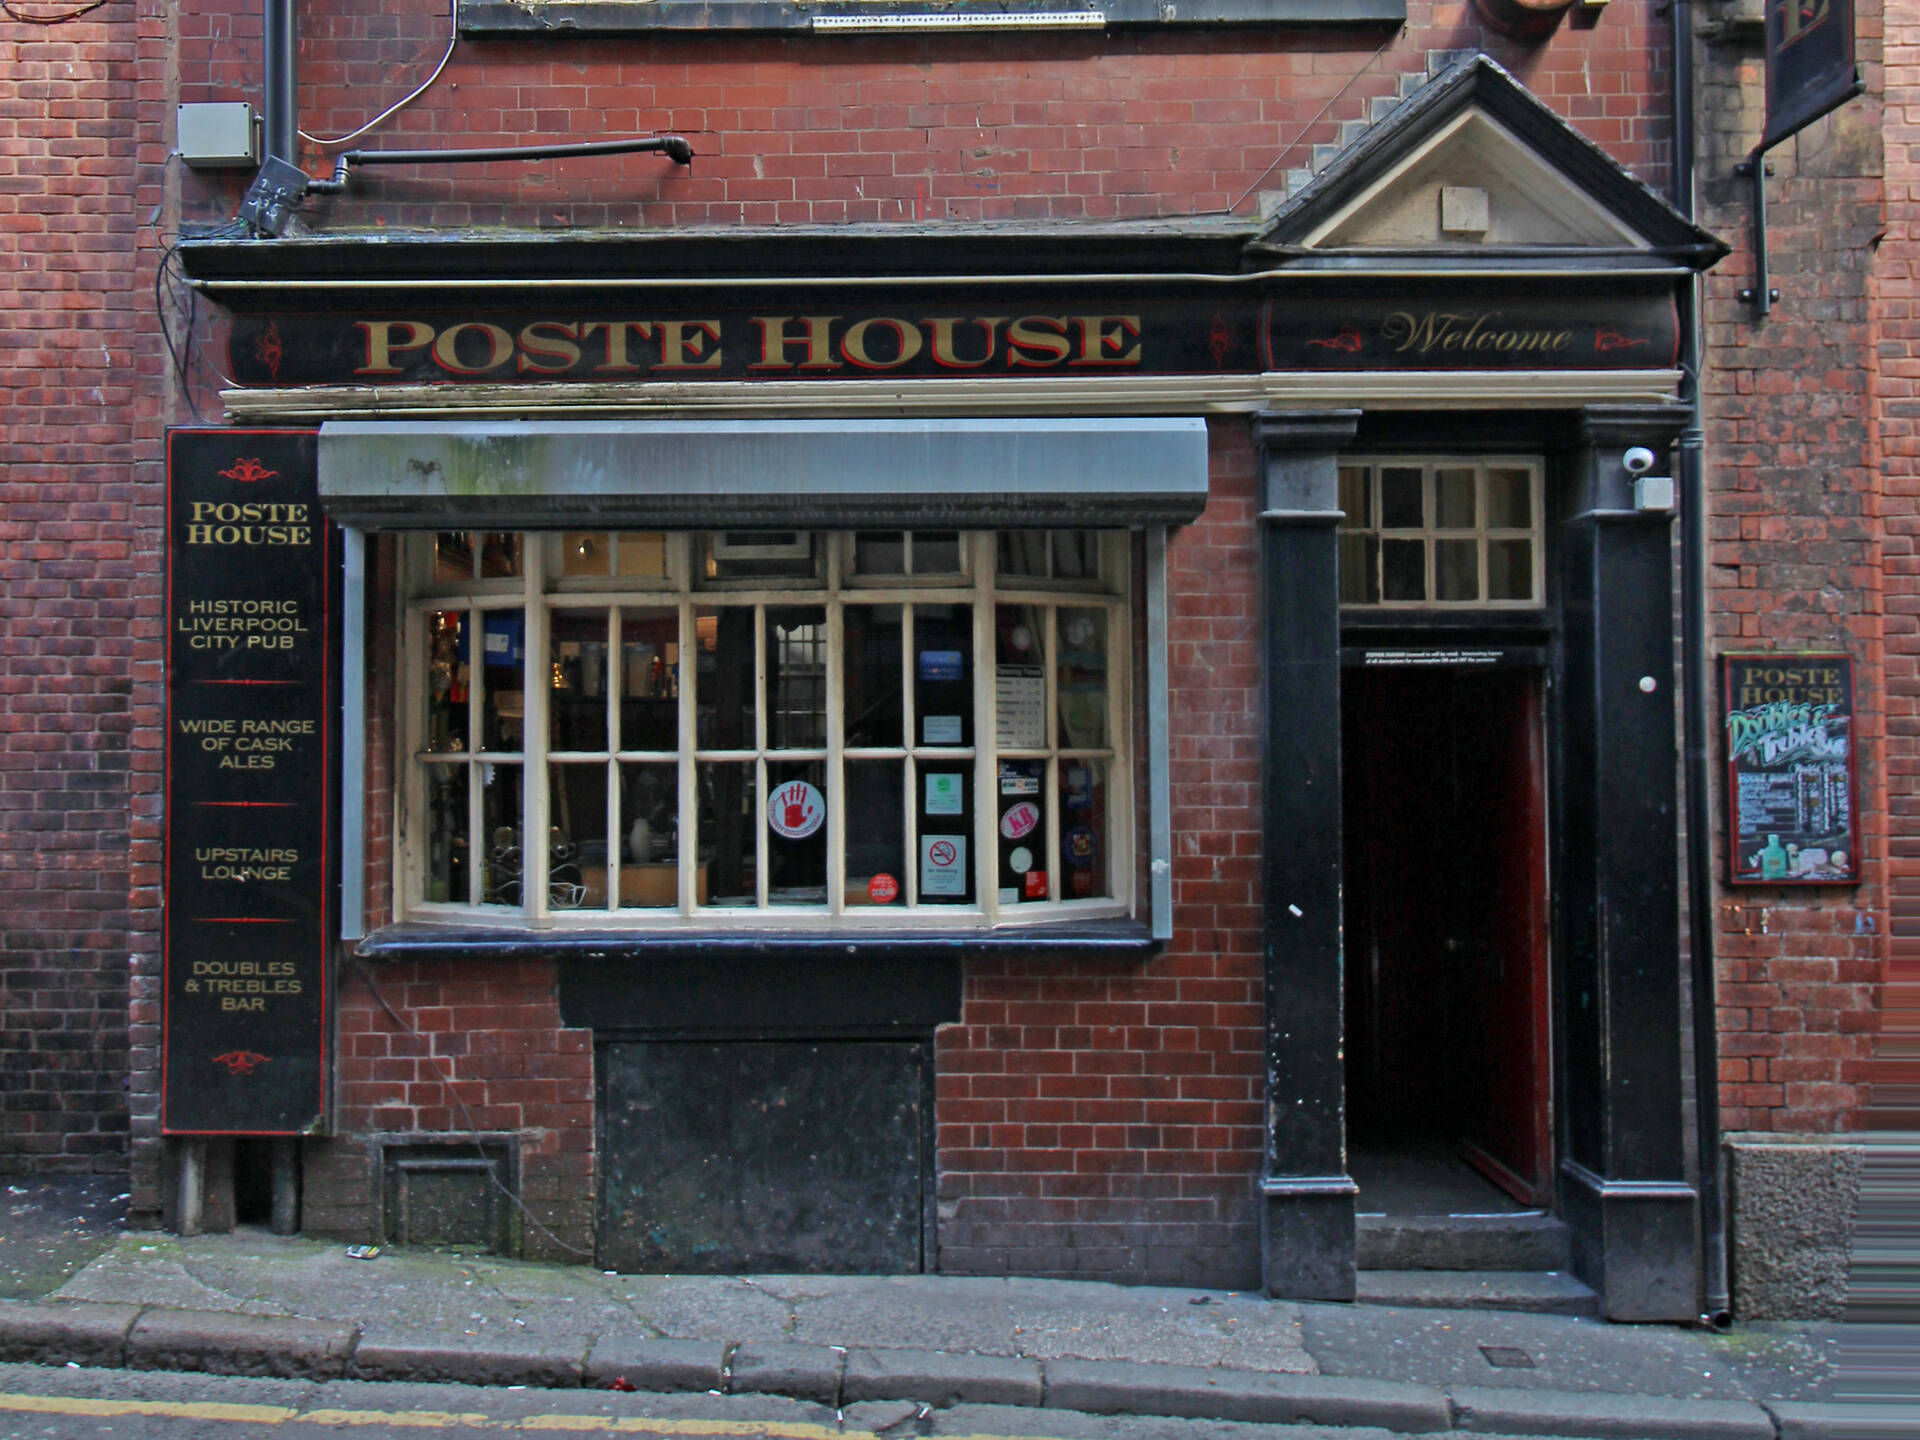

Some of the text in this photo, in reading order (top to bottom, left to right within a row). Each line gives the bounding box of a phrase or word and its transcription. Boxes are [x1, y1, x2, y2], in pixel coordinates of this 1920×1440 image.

[1382, 310, 1574, 353] Welcome
[353, 315, 1142, 375] POSTE HOUSE
[192, 501, 309, 523] POSTE
[185, 524, 312, 546] HOUSE
[189, 600, 298, 614] HISTORIC
[179, 617, 308, 632] LIVERPOOL
[190, 635, 295, 649] CITY PUB
[1744, 668, 1841, 686] POSTE
[1742, 686, 1844, 705] HOUSE
[180, 719, 315, 734] WIDE RANGE
[201, 738, 293, 752] OF CASK
[218, 755, 275, 770] ALES
[195, 848, 299, 863] UPSTAIRS
[202, 865, 291, 881] LOUNGE
[192, 961, 296, 976] DOUBLES
[184, 979, 302, 994] & TREBLES
[221, 997, 265, 1012] BAR
